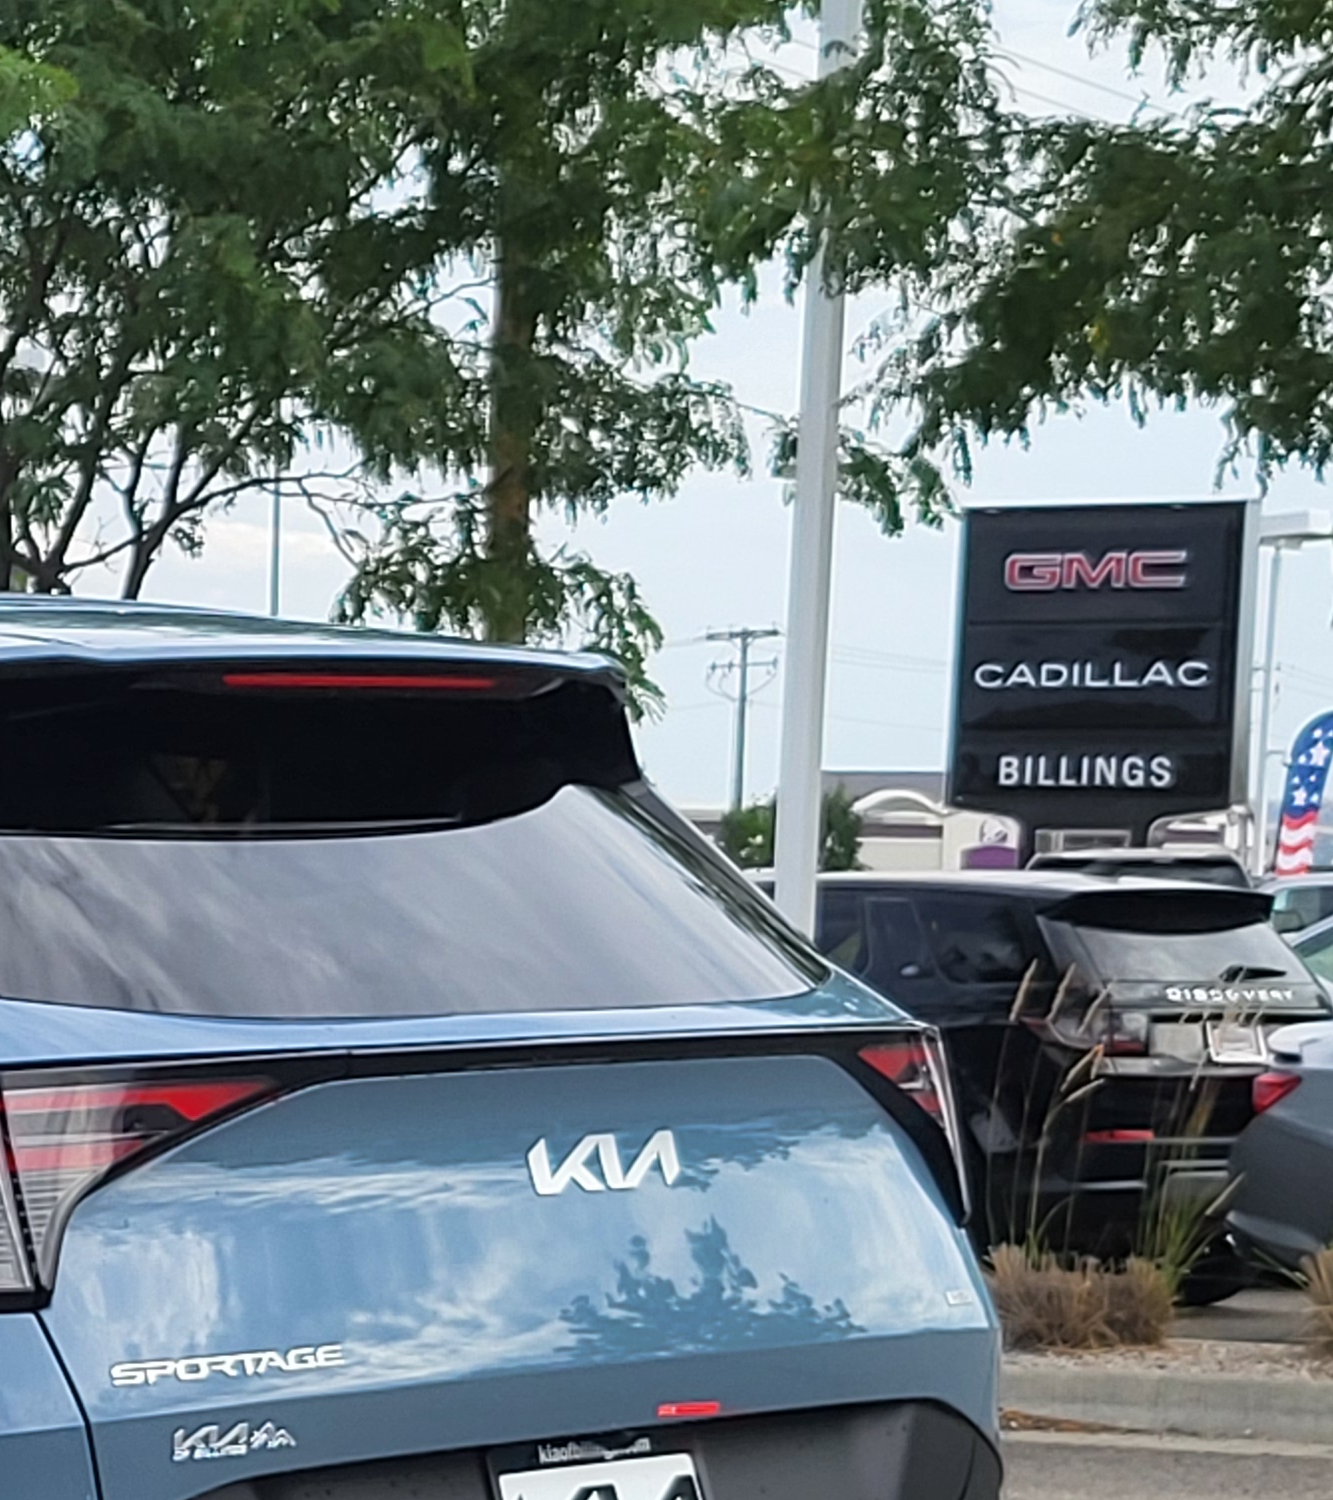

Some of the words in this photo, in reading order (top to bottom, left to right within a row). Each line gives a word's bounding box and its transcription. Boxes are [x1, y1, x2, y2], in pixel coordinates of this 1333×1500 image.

[1005, 550, 1188, 591] GMC
[974, 661, 1210, 688] CADILLAC
[998, 755, 1173, 788] BILLINGS
[1165, 986, 1294, 1002] DISCOVERY
[527, 1129, 680, 1195] KIA
[111, 1345, 345, 1387] SPORTAGE
[173, 1422, 249, 1450] KIA
